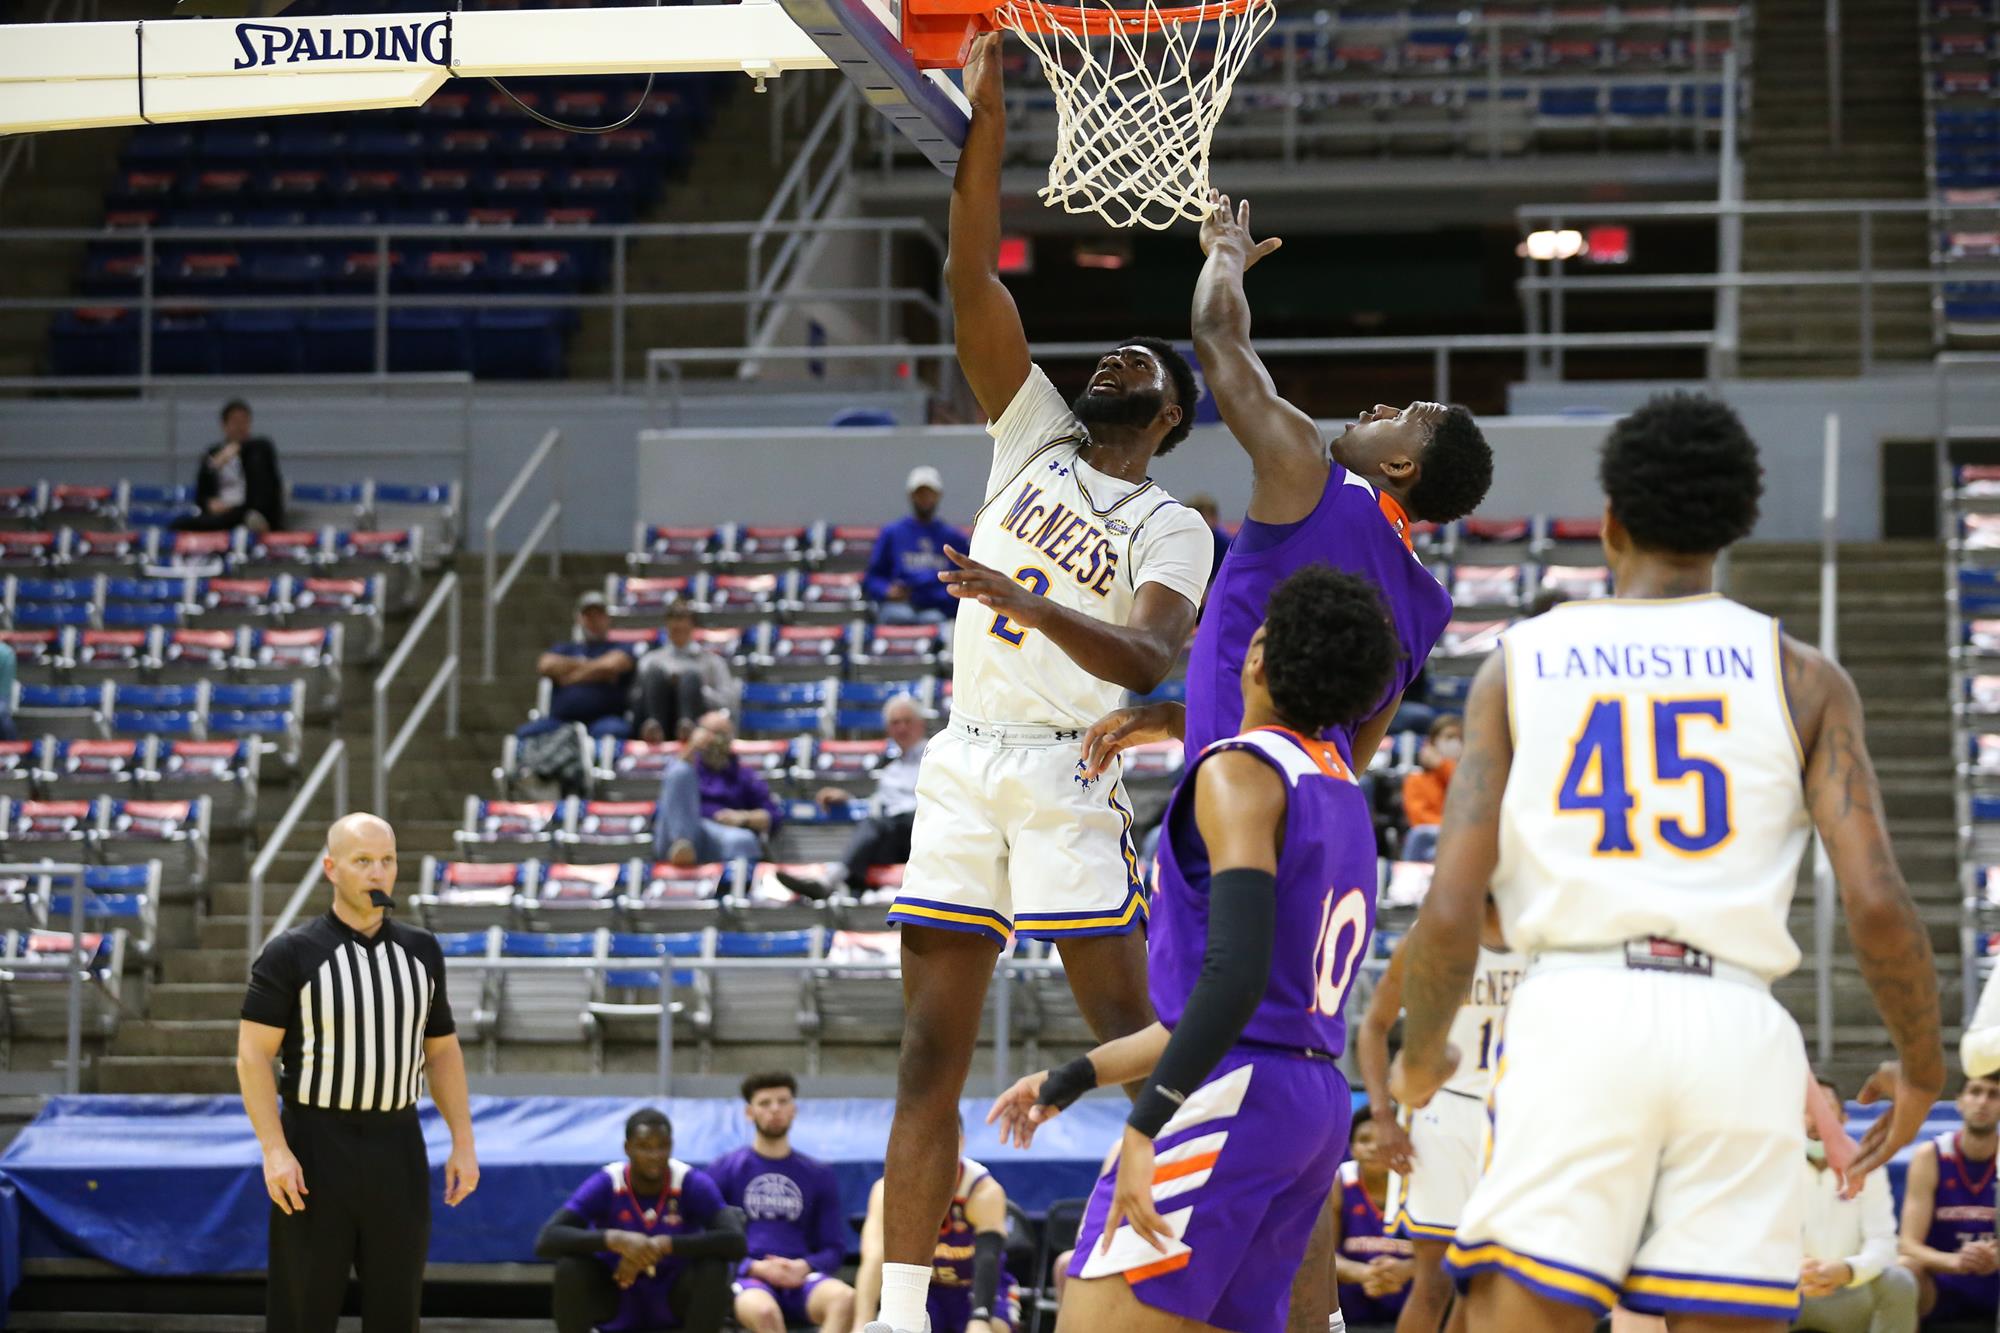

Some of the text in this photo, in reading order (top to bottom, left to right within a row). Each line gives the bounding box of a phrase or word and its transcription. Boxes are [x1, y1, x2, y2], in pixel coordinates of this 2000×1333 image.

[234, 19, 452, 70] SPALDING
[987, 564, 1054, 649] 2
[1536, 644, 1754, 680] LANGSTON
[1554, 692, 1736, 858] 45
[1307, 886, 1367, 1017] 10
